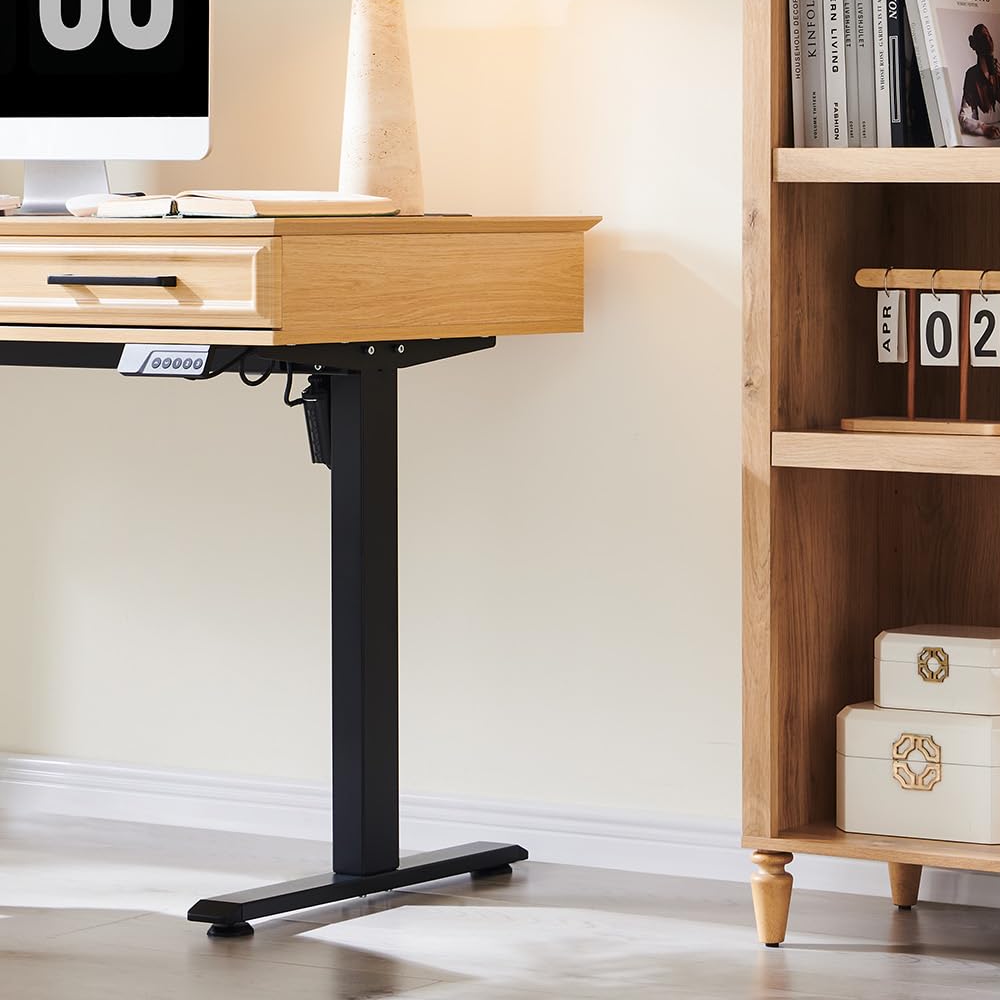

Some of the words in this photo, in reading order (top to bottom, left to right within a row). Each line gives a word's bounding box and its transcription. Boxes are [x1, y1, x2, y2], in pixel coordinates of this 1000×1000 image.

[844, 2, 852, 48] LIVSHJULET
[924, 14, 932, 38] FROM
[932, 54, 941, 80] VEGAS
[830, 28, 840, 73] LIVING
[882, 306, 892, 352] APR
